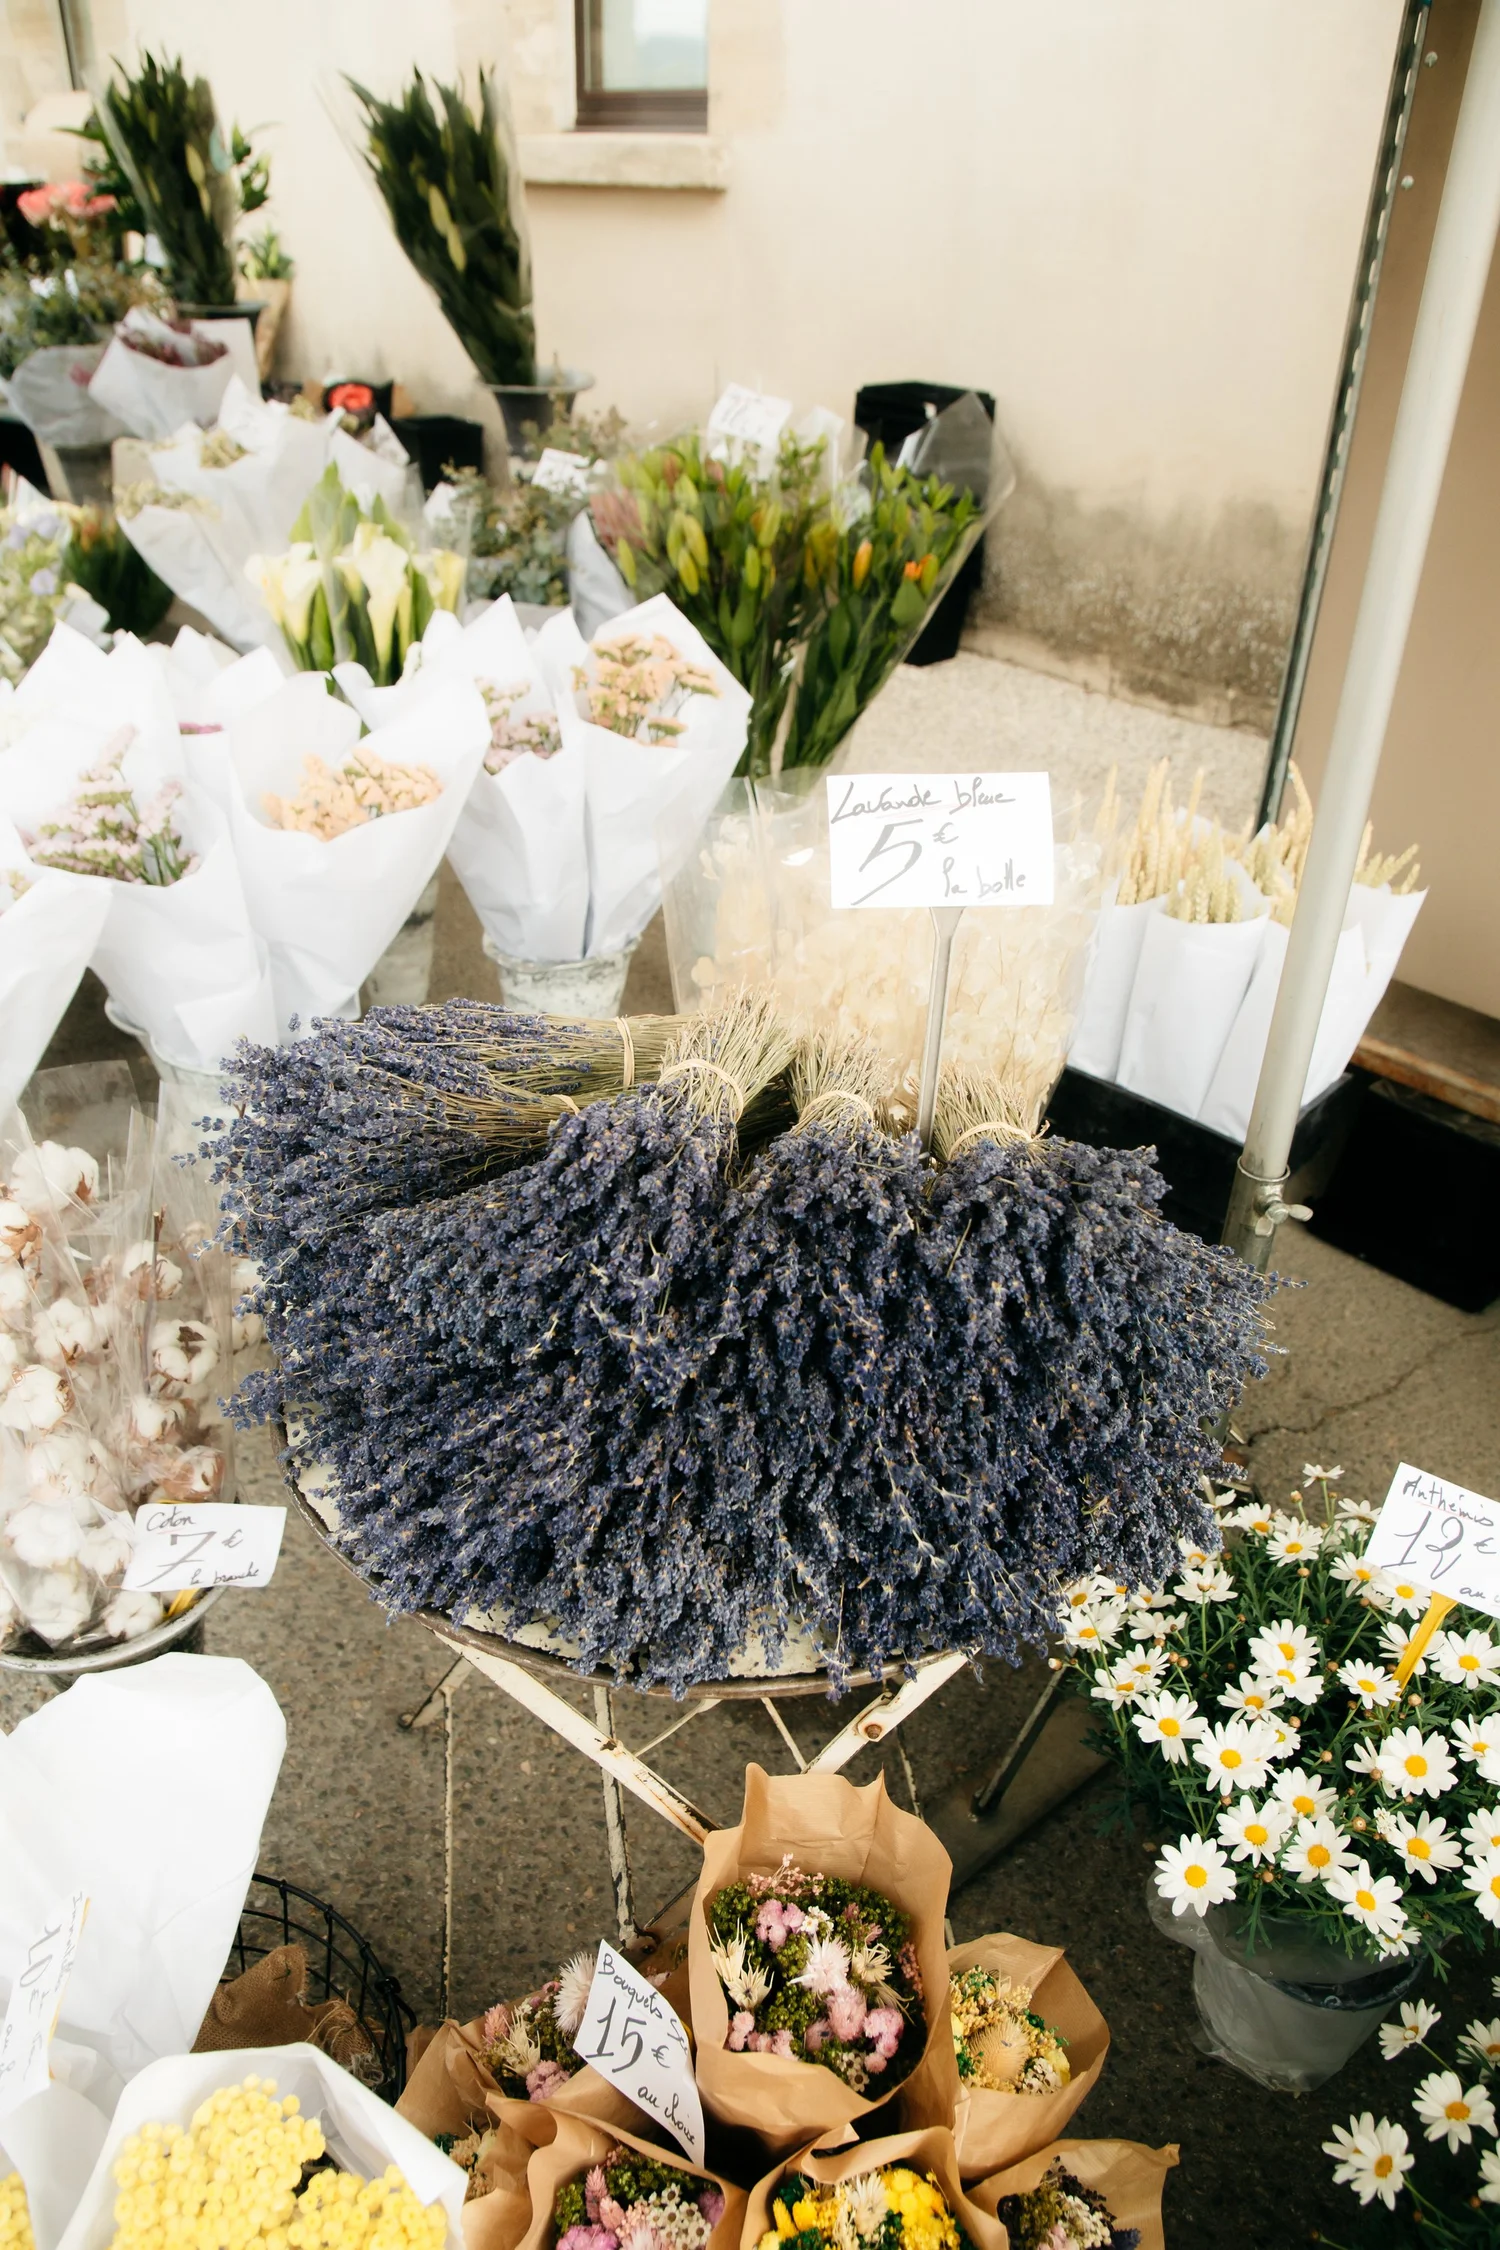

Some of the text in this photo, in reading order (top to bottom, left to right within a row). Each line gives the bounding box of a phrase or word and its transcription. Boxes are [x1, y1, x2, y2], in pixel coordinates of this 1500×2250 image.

[831, 777, 1016, 824] Lavande bleue
[851, 818, 959, 906] 5 €
[942, 857, 1026, 898] la botte
[146, 1506, 196, 1532] Coton
[137, 1529, 243, 1588] 7 €
[1381, 1510, 1498, 1580] 12 €
[190, 1561, 260, 1585] la branche
[1459, 1586, 1487, 1599] au
[597, 1953, 664, 2020] Bouquets
[585, 1996, 672, 2074] 15 €
[637, 2086, 661, 2110] au
